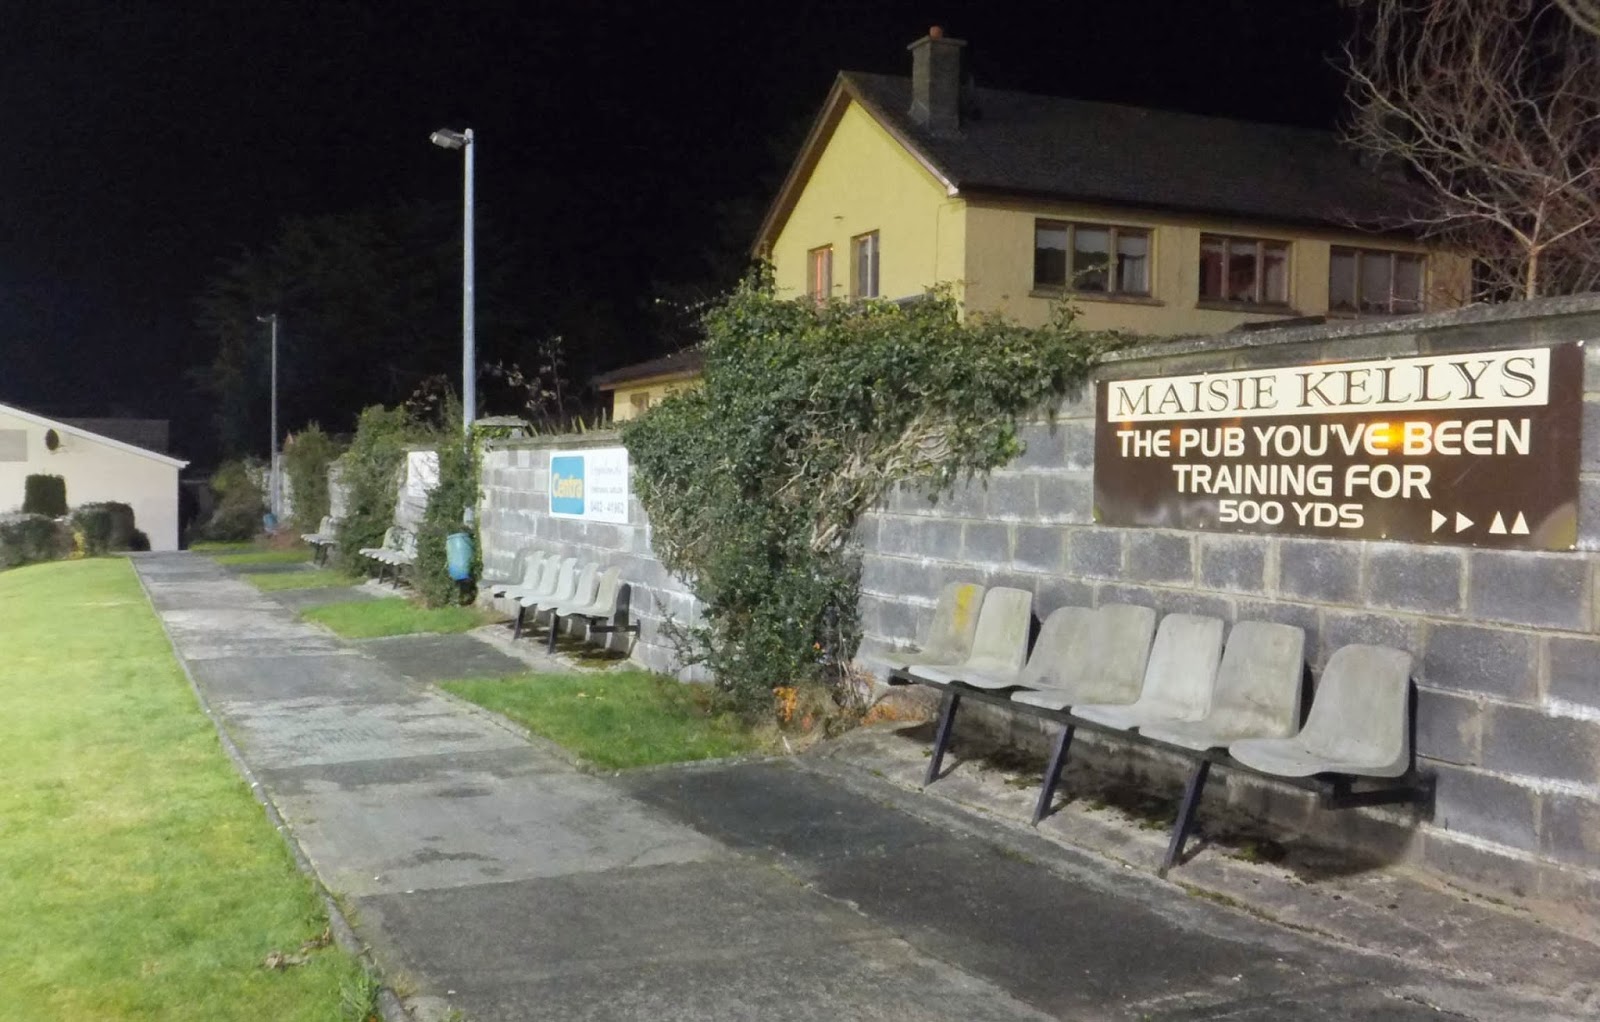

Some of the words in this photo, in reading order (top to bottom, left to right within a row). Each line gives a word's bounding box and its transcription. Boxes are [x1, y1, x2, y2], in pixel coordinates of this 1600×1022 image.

[1116, 374, 1279, 416] MAISIE
[1295, 357, 1537, 408] KELLYS
[1116, 429, 1171, 458] THE
[1179, 426, 1245, 457] PUB
[1252, 422, 1390, 457] YOU'VE
[1402, 418, 1531, 456] BEEN
[552, 472, 583, 499] Centra
[1172, 463, 1333, 497] TRAINING
[1344, 464, 1432, 499] FOR
[1219, 499, 1284, 525] 500
[1291, 501, 1365, 528] YDS
